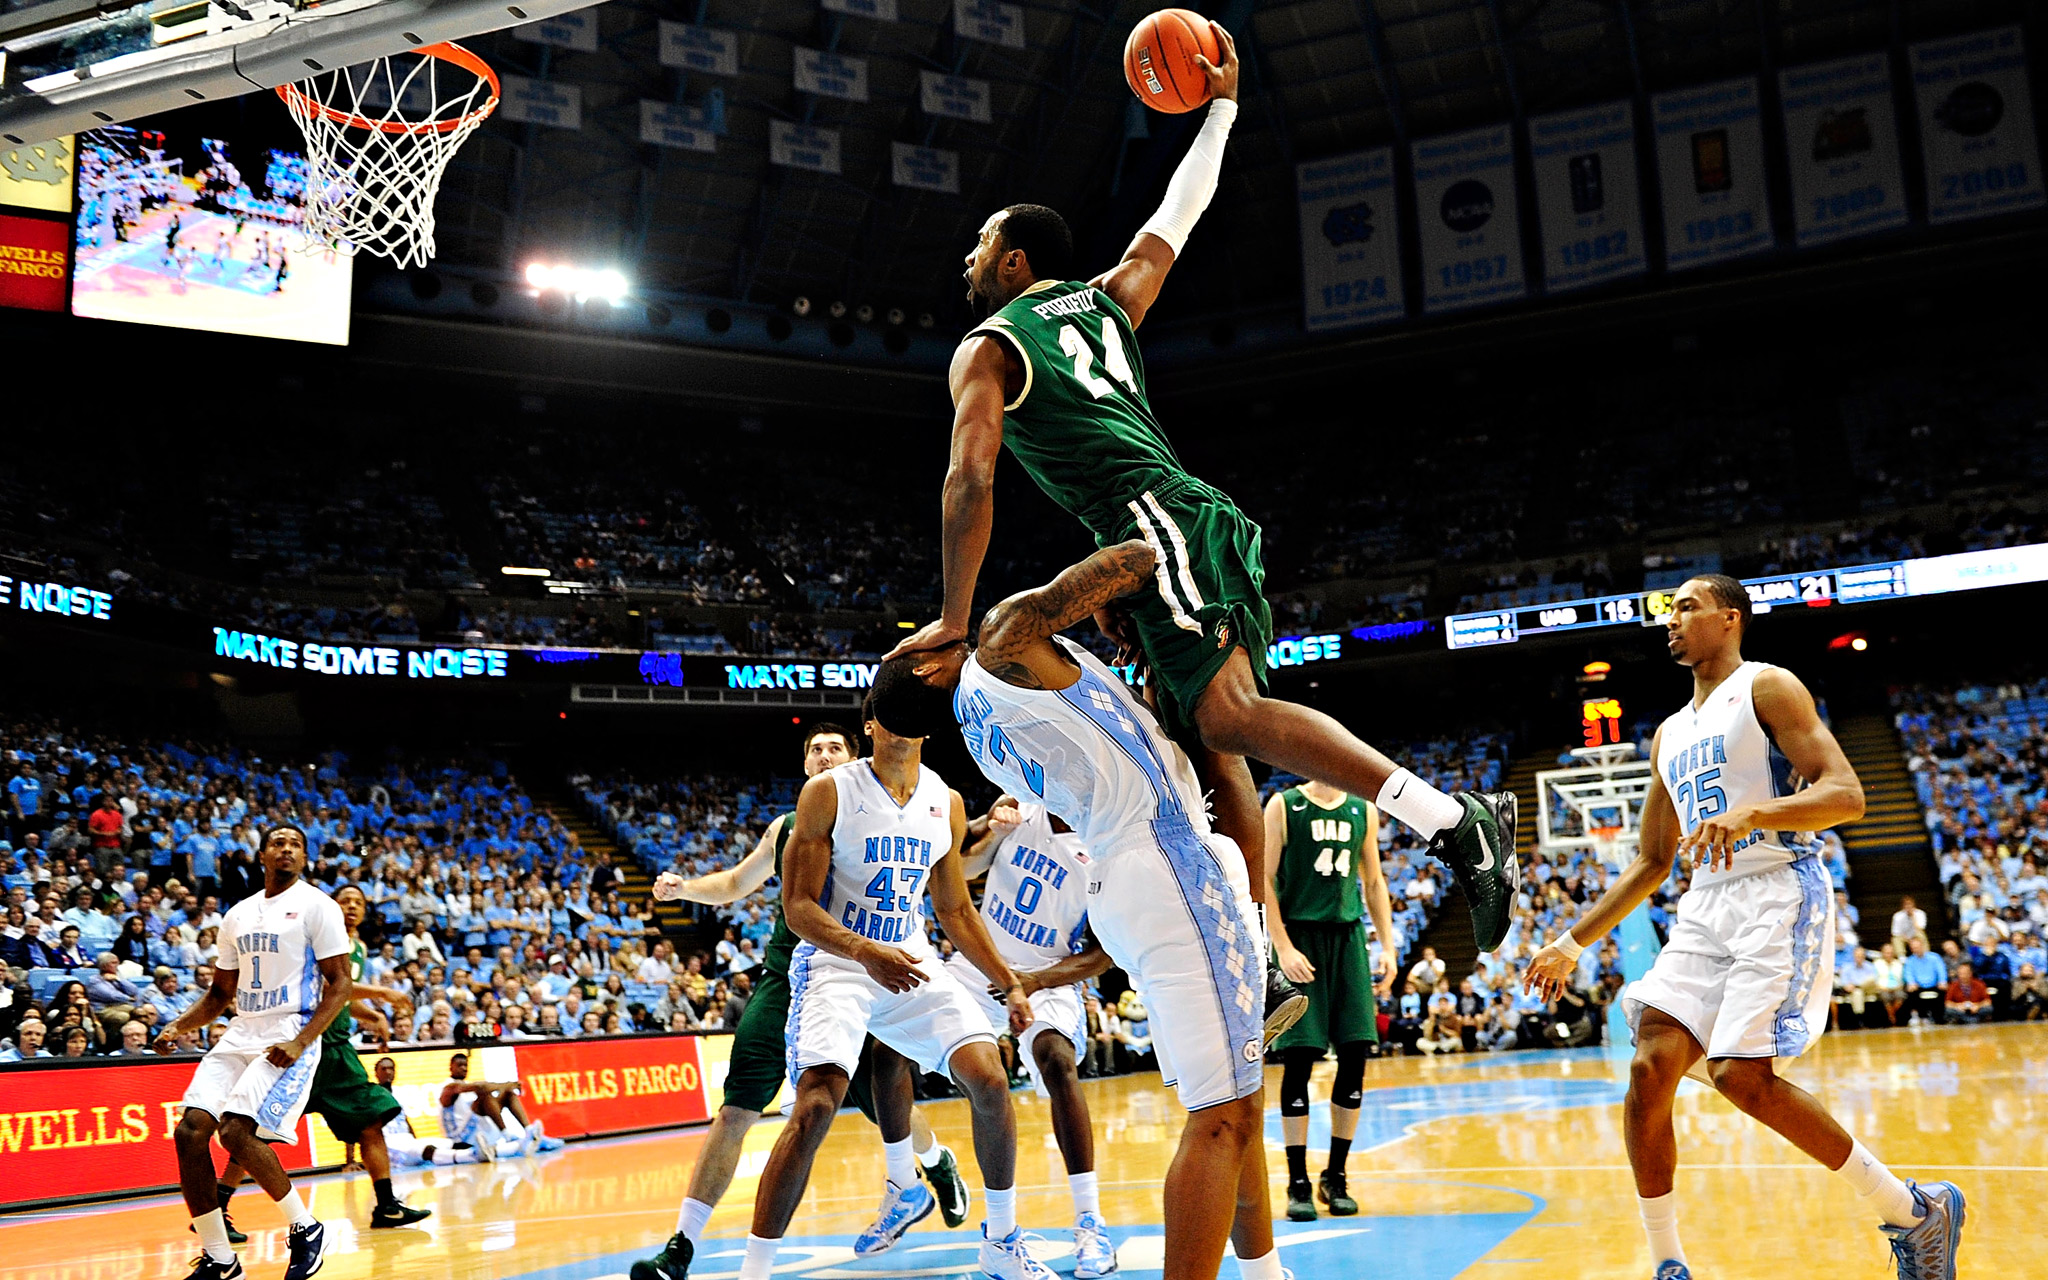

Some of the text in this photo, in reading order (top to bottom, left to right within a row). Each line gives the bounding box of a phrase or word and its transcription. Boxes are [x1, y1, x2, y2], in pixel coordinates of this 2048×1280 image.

[0, 245, 66, 266] WELLS
[0, 259, 65, 279] FARGO
[1439, 254, 1508, 288] 1957
[1322, 276, 1387, 308] 1924
[1058, 316, 1139, 400] 24
[20, 581, 113, 620] NOISE
[1800, 575, 1831, 601] 21
[1539, 608, 1578, 627] UAB
[1604, 598, 1634, 623] 15
[213, 627, 508, 678] MAKE SOME NOISE
[724, 663, 880, 690] MAKE SOM
[1582, 718, 1620, 747] 31
[989, 723, 1045, 799] 2
[1668, 734, 1727, 788] NORTH
[1677, 767, 1728, 834] 25
[1311, 819, 1352, 842] UAB
[864, 836, 931, 867] NORTH
[1010, 845, 1068, 890] NORTH
[1313, 847, 1351, 878] 44
[865, 866, 924, 912] 43
[1014, 876, 1043, 915] 0
[842, 900, 917, 943] CAROL
[987, 893, 1058, 948] CAROLINA
[236, 932, 279, 955] NORTH
[251, 956, 262, 989] 1
[527, 1062, 699, 1105] WELLS FARGO
[0, 1104, 149, 1153] WELLS
